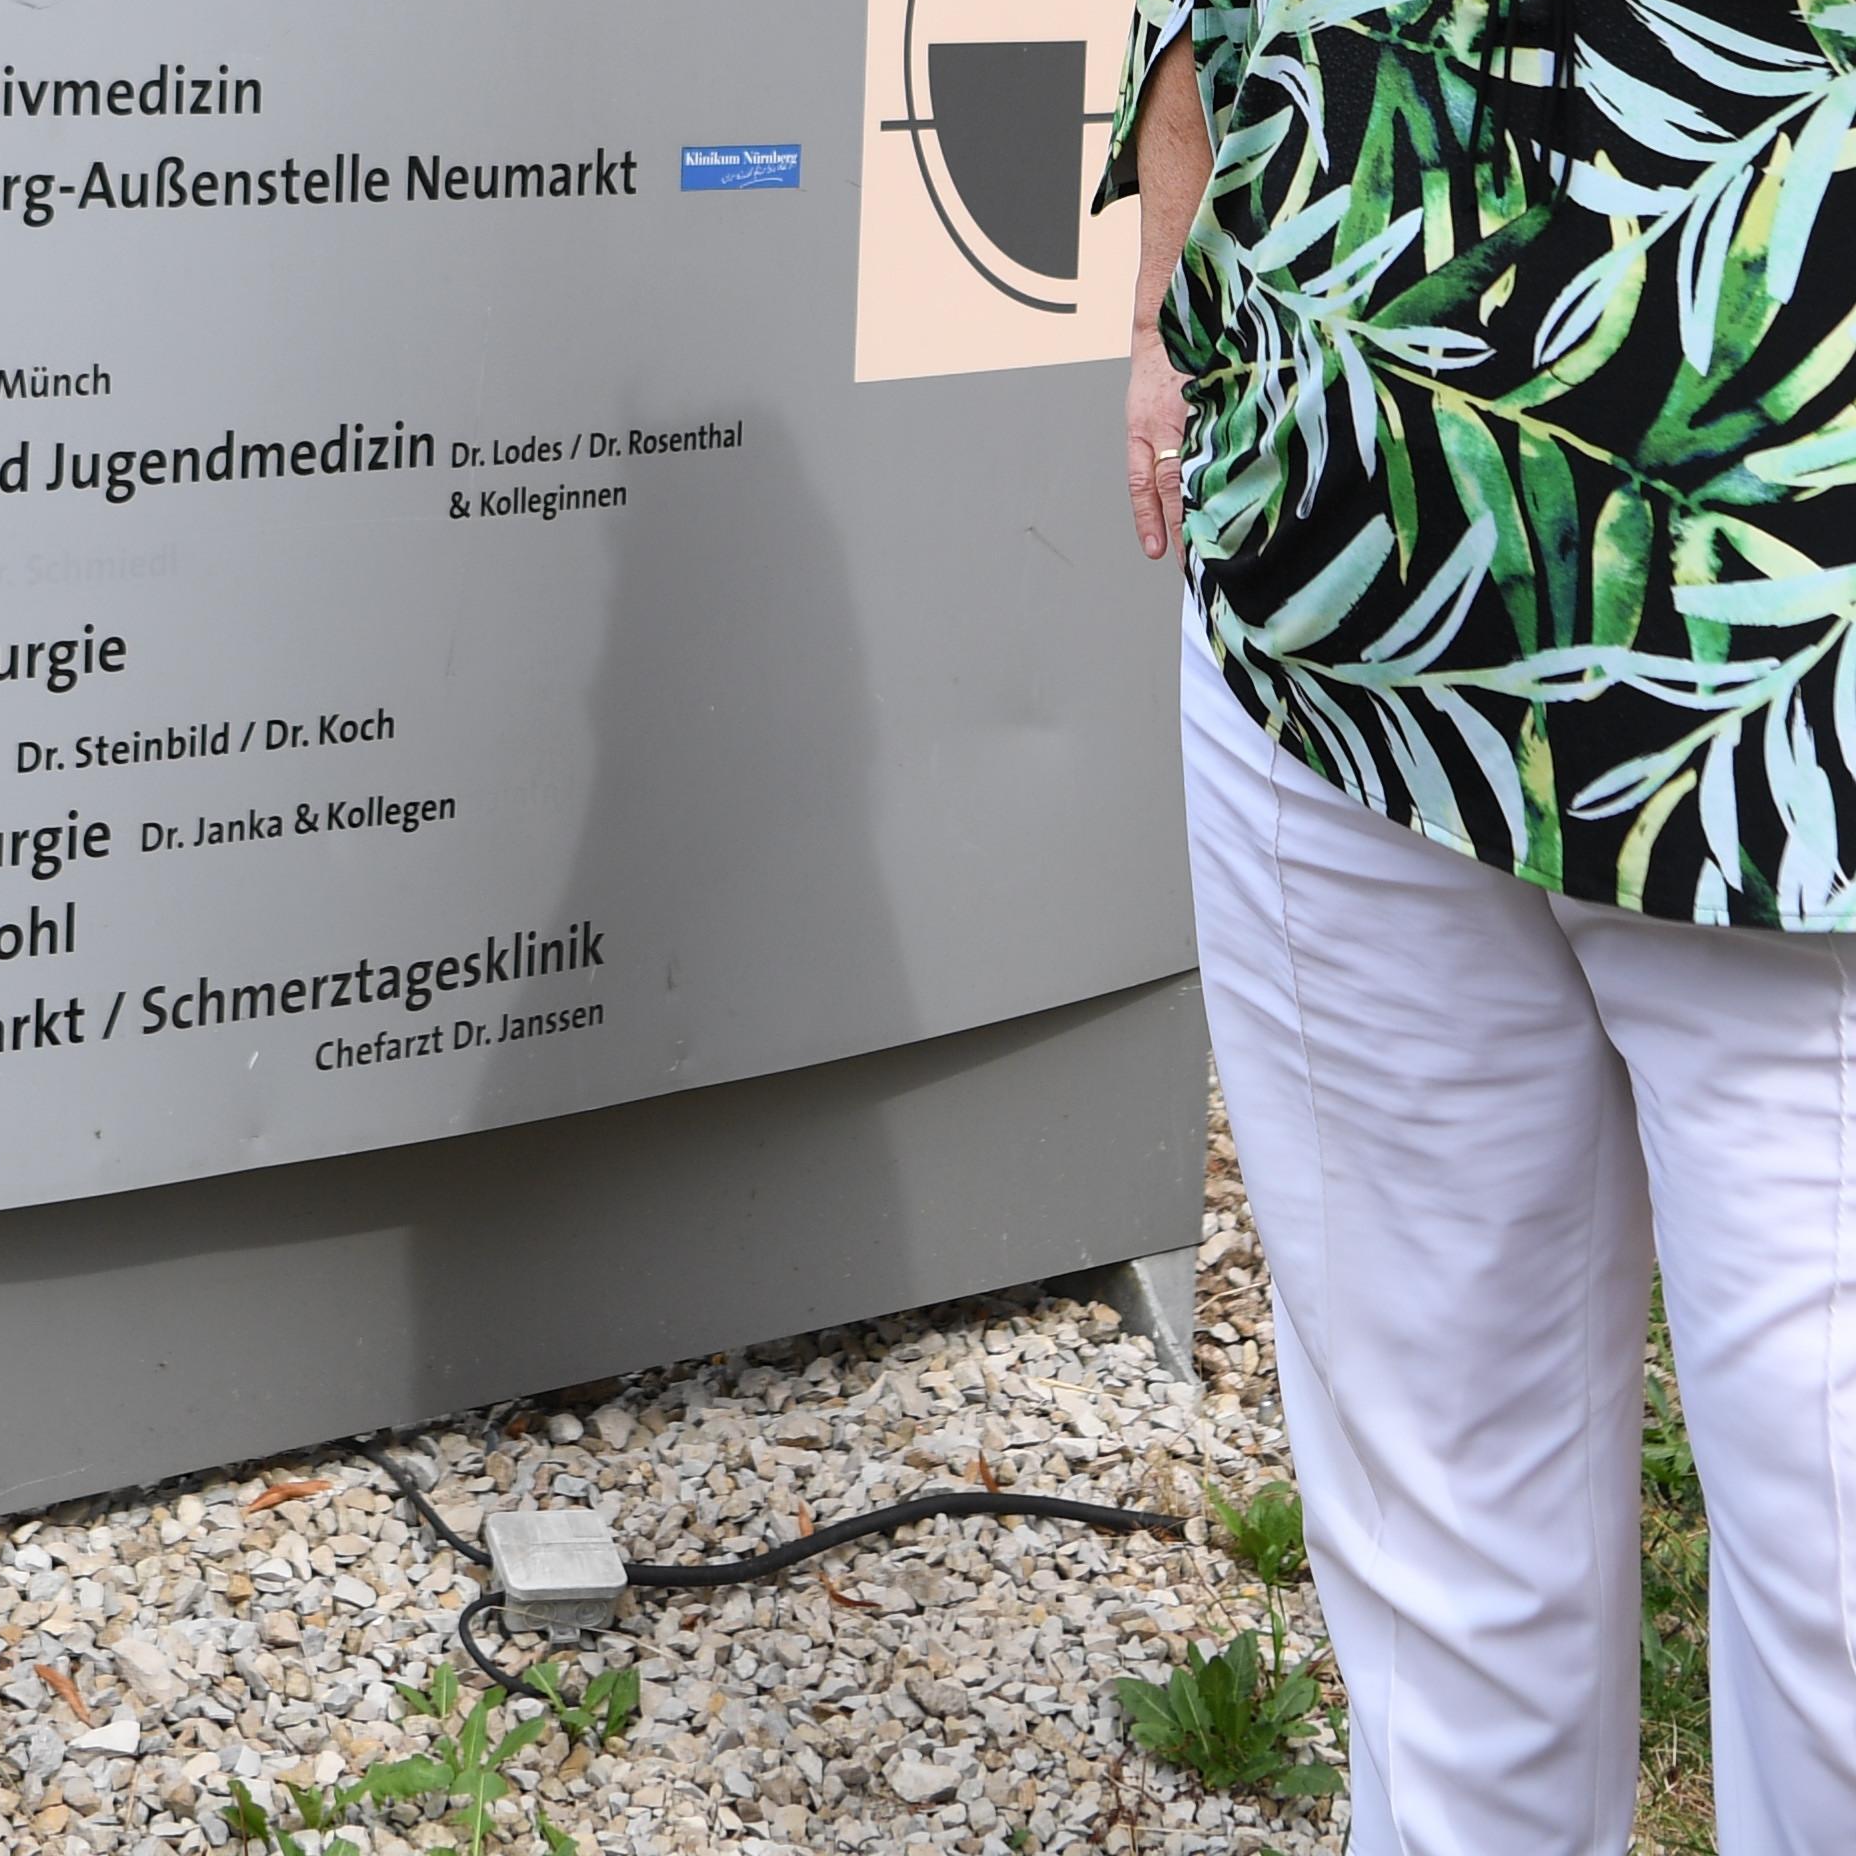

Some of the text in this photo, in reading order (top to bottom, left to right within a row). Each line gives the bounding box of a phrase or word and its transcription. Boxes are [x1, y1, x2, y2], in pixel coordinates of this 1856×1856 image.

[405, 146, 639, 203] Neumarkt
[685, 150, 799, 166] Klinikum Nürnberg
[44, 419, 436, 505] Jugendmedizin
[450, 440, 487, 470] Dr.
[492, 433, 564, 467] Lodes
[568, 432, 584, 461] /
[588, 431, 623, 460] Dr.
[627, 418, 744, 457] Rosenthal
[447, 482, 628, 522] & Kolleginnen
[16, 740, 66, 775] Dr.
[74, 720, 231, 770] Steinbild
[238, 720, 258, 754] /
[264, 718, 311, 752] Dr.
[317, 706, 396, 747] Koch
[140, 821, 186, 854] Dr.
[191, 807, 284, 849] Janka
[292, 801, 321, 836] &
[326, 794, 457, 835] Kollegen
[100, 990, 128, 1041] /
[140, 919, 606, 1036] Schmerztagesklinik
[314, 1002, 605, 1072] Chefarzt Dr. Janssen
